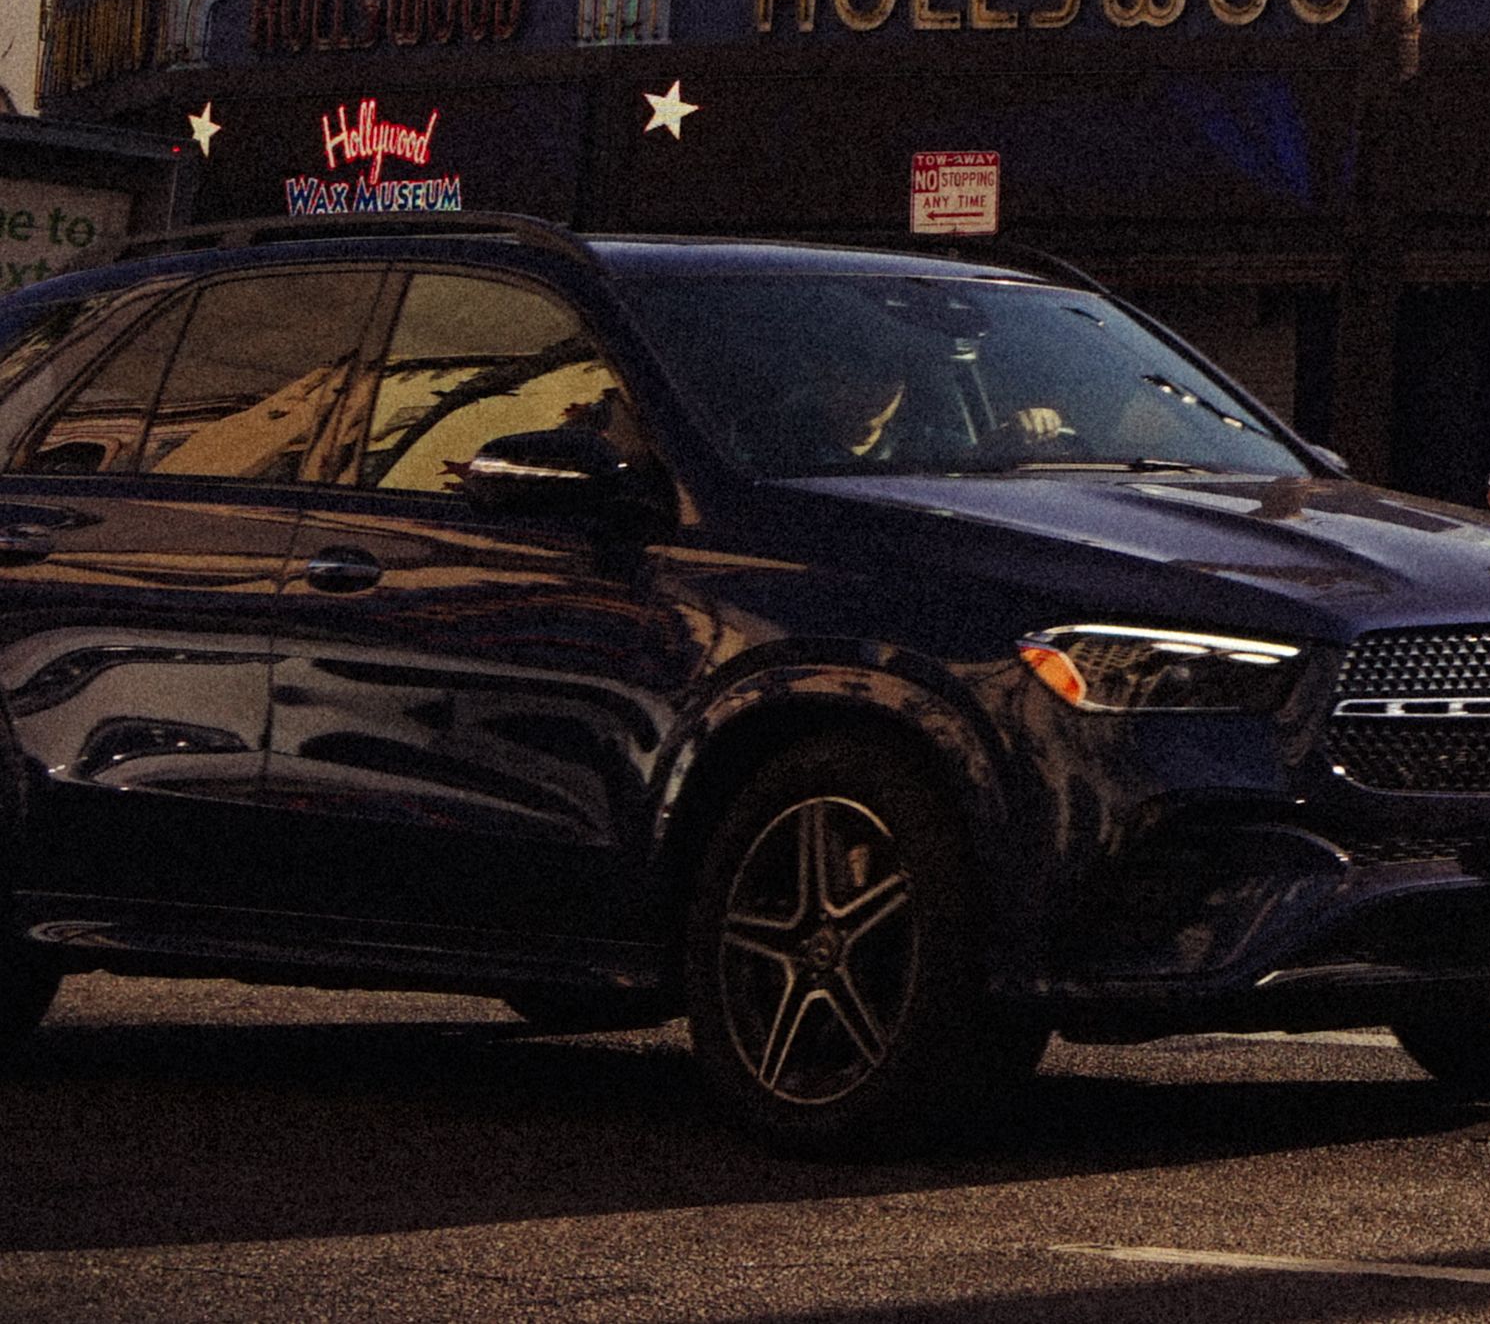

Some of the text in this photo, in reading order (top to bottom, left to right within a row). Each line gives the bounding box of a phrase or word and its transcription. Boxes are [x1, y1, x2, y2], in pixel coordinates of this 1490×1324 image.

[321, 98, 439, 185] Hollywood
[916, 154, 996, 166] TOW-AWAY
[915, 170, 995, 191] NO STOPPING
[923, 195, 987, 208] ANY TIME
[48, 207, 96, 248] to
